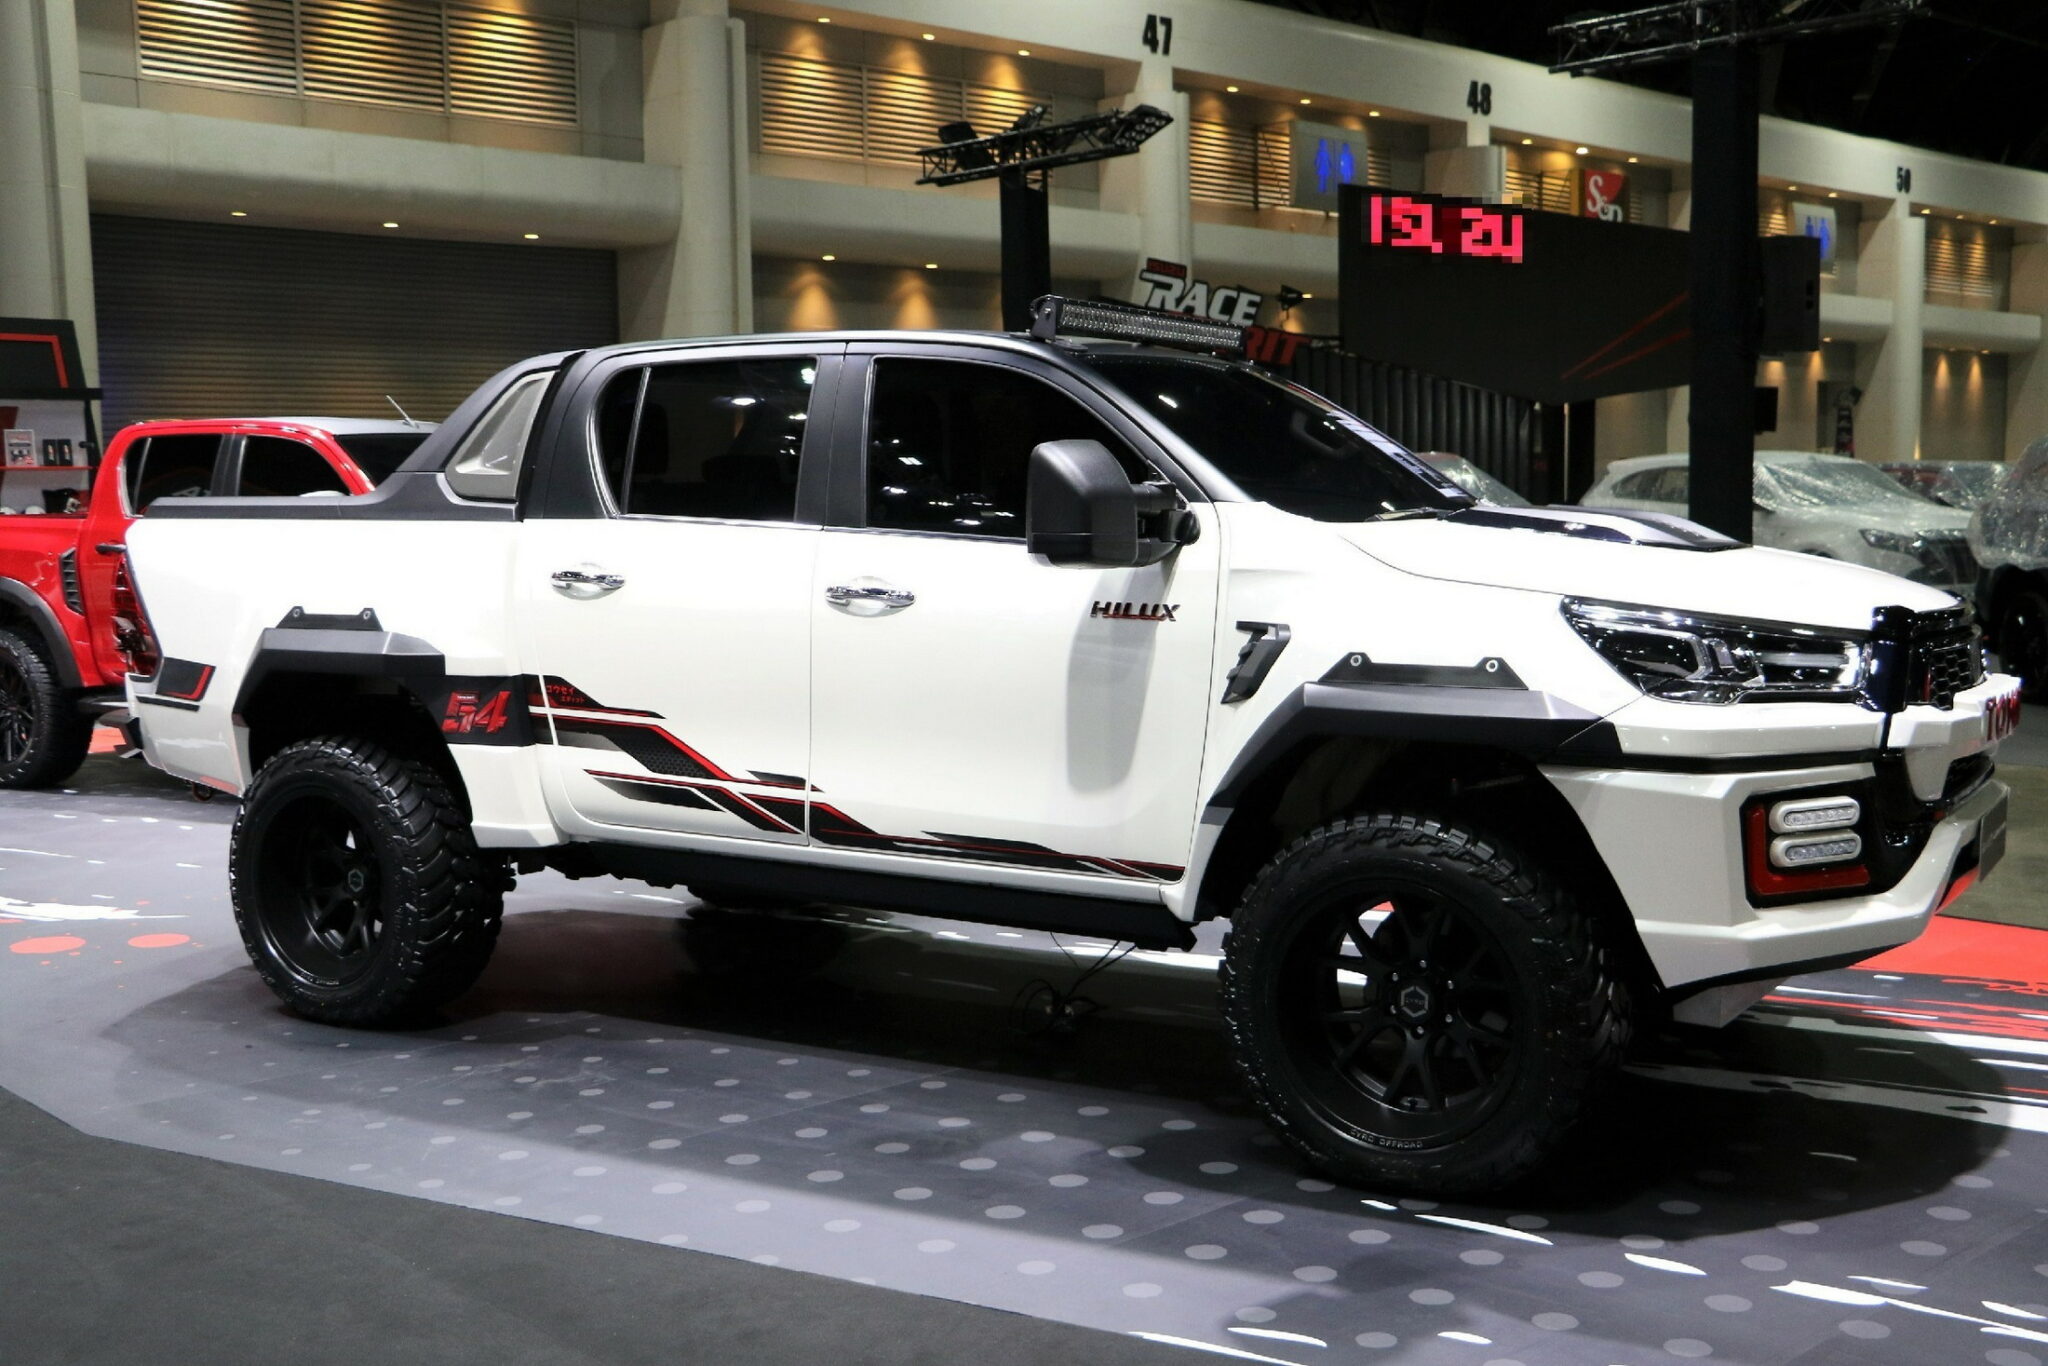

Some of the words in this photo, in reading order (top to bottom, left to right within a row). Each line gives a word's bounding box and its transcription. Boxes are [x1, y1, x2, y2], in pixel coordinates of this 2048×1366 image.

[1142, 14, 1172, 56] 47
[1466, 80, 1492, 116] 48
[1896, 166, 1911, 194] 50
[1140, 270, 1262, 326] RACE
[1090, 600, 1180, 622] HILUX
[441, 690, 512, 733] 54
